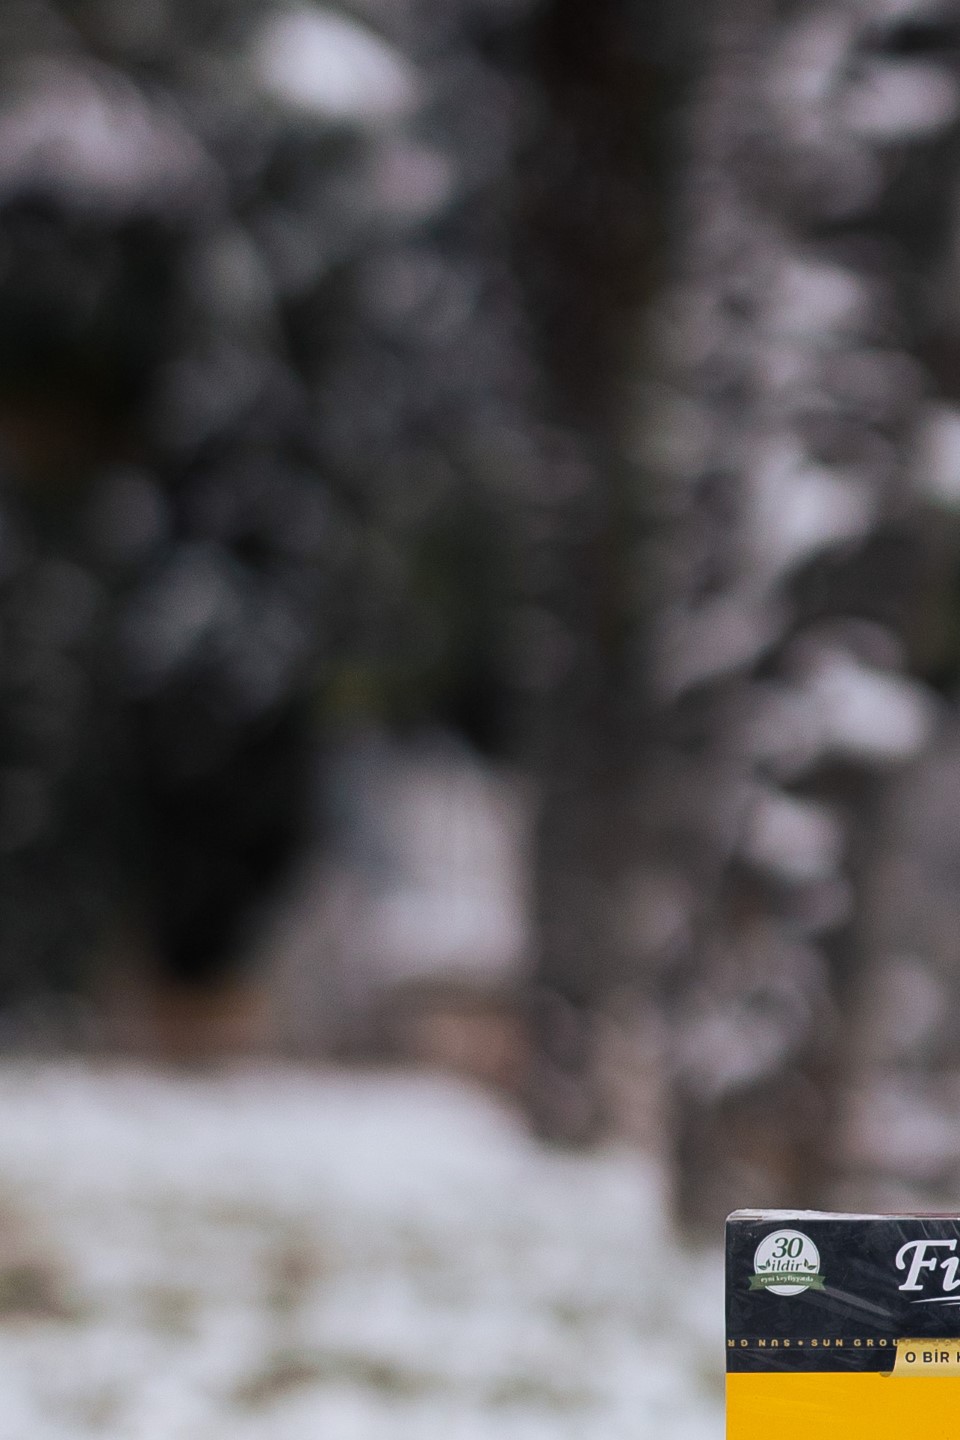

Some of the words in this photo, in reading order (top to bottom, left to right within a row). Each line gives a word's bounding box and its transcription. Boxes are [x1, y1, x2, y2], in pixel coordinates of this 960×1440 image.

[772, 1237, 803, 1258] 30
[771, 1260, 803, 1271] ildir
[811, 1338, 843, 1347] SUN
[905, 1351, 916, 1363] O
[923, 1348, 949, 1363] BİR
